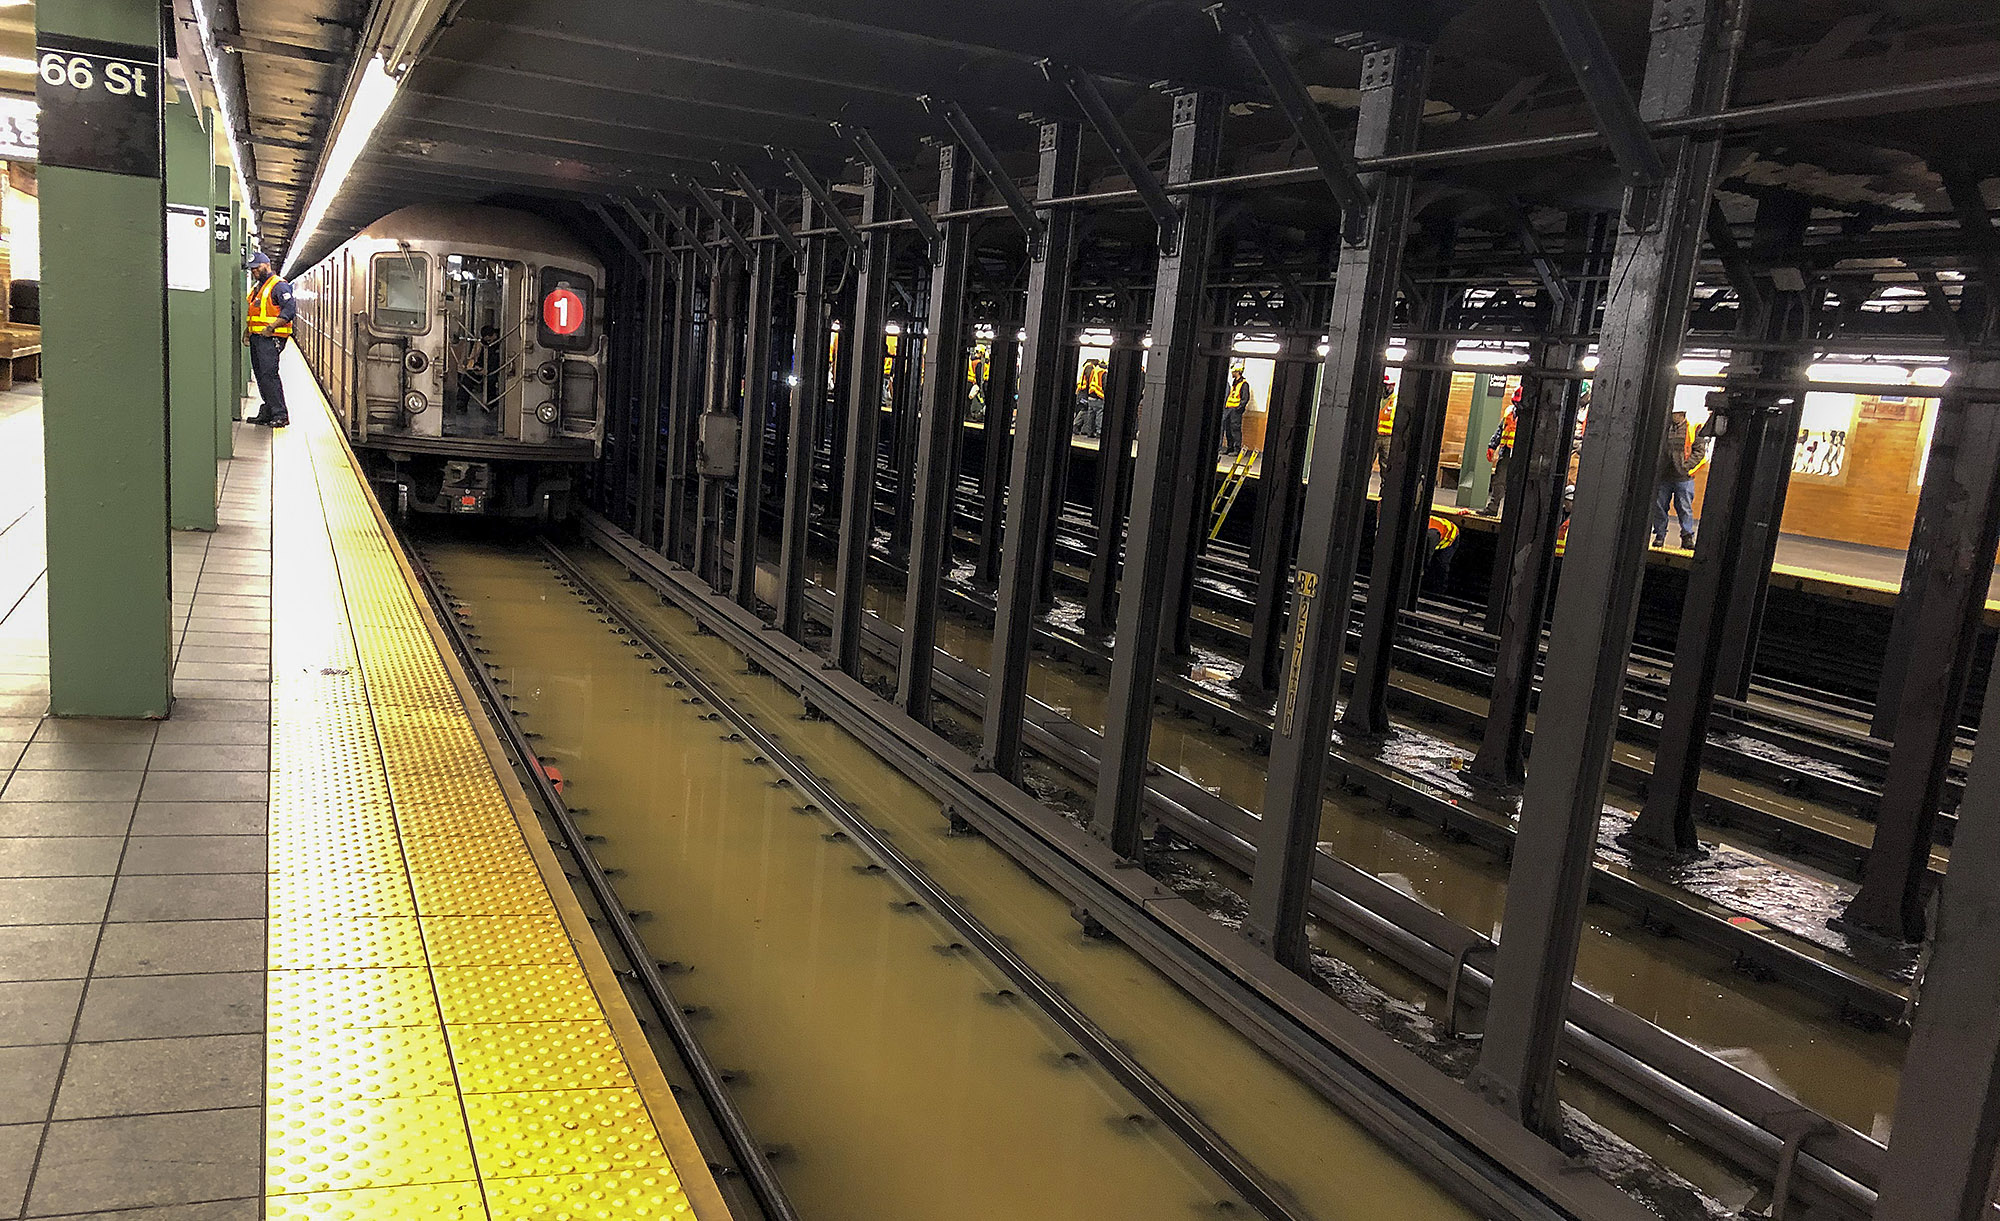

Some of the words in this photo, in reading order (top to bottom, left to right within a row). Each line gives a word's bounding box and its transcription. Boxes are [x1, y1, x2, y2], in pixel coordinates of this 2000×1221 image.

[40, 53, 93, 89] 66
[104, 62, 147, 97] St
[214, 230, 229, 241] er
[554, 297, 568, 327] 1
